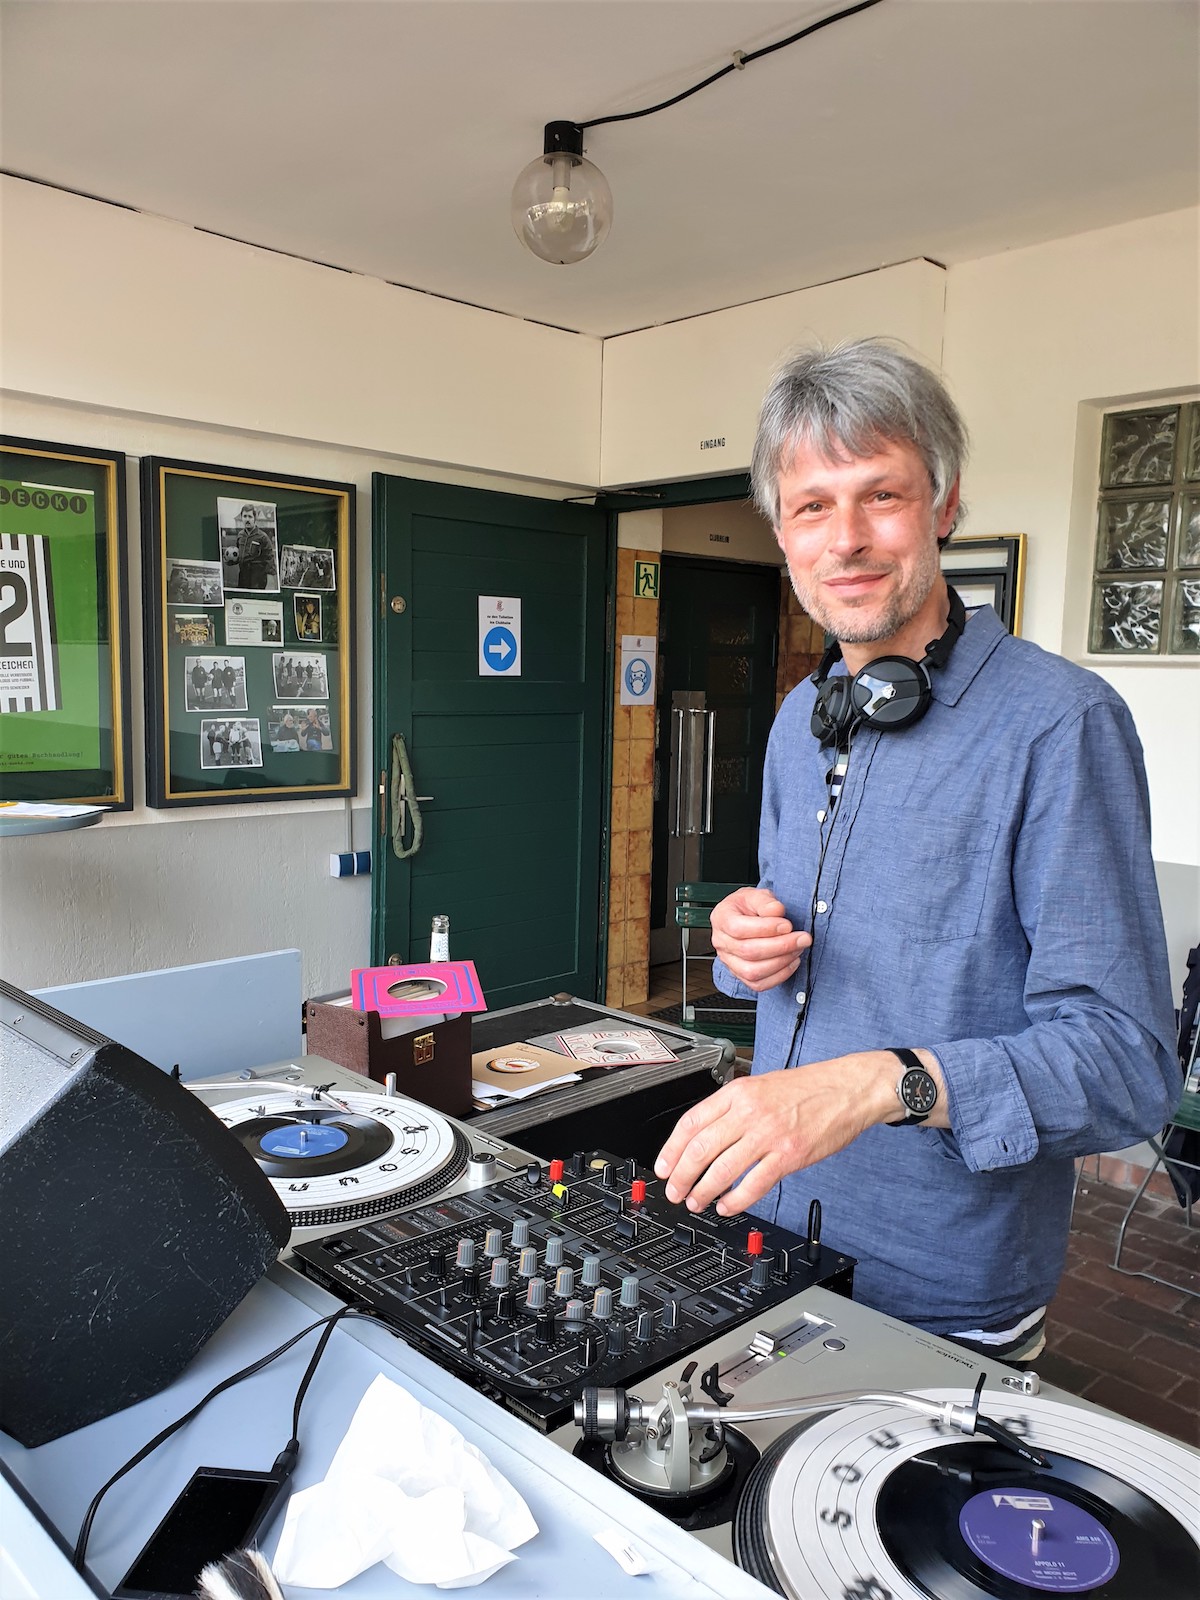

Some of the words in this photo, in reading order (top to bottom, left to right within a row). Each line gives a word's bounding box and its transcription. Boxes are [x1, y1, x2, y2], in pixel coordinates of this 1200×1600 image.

[700, 437, 726, 450] EINGANG
[8, 559, 26, 569] UND
[590, 1029, 649, 1040] TROJAN
[936, 1350, 974, 1370] Technics
